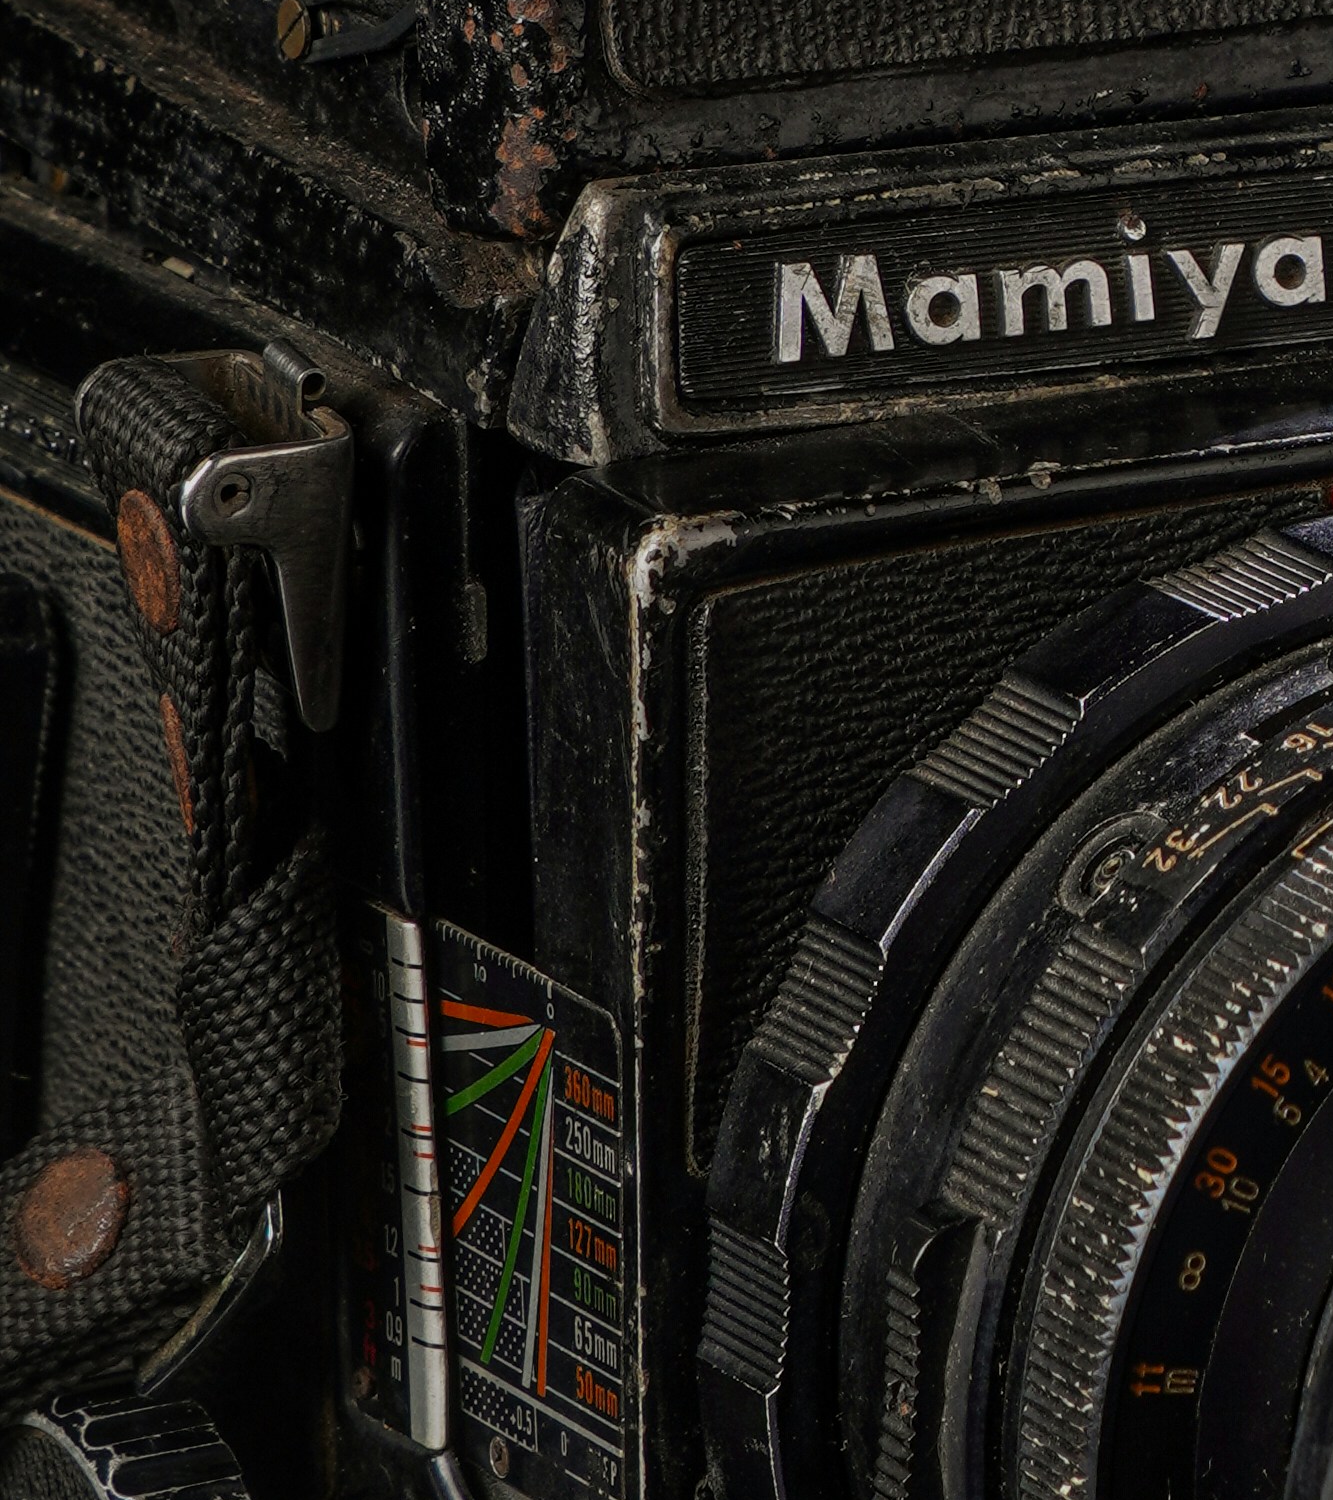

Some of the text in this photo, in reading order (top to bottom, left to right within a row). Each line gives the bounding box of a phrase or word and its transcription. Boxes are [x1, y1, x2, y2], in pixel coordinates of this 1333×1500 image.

[773, 212, 1327, 365] Mamiya
[472, 963, 487, 983] 10
[564, 1064, 616, 1122] 360mm
[1250, 1053, 1291, 1100] 15
[1303, 1057, 1330, 1088] 4
[1272, 1096, 1302, 1127] 5
[565, 1116, 616, 1174] 250mm
[567, 1168, 617, 1223] 180mm
[1194, 1145, 1239, 1199] 30
[1221, 1176, 1260, 1215] 10
[568, 1217, 618, 1272] 127mm
[393, 1276, 400, 1307] 1
[573, 1267, 617, 1321] 90mm
[385, 1310, 402, 1347] 0.9
[574, 1315, 618, 1370] 65mm
[391, 1355, 402, 1383] m
[576, 1364, 619, 1419] 50mm
[560, 1431, 568, 1456] 0
